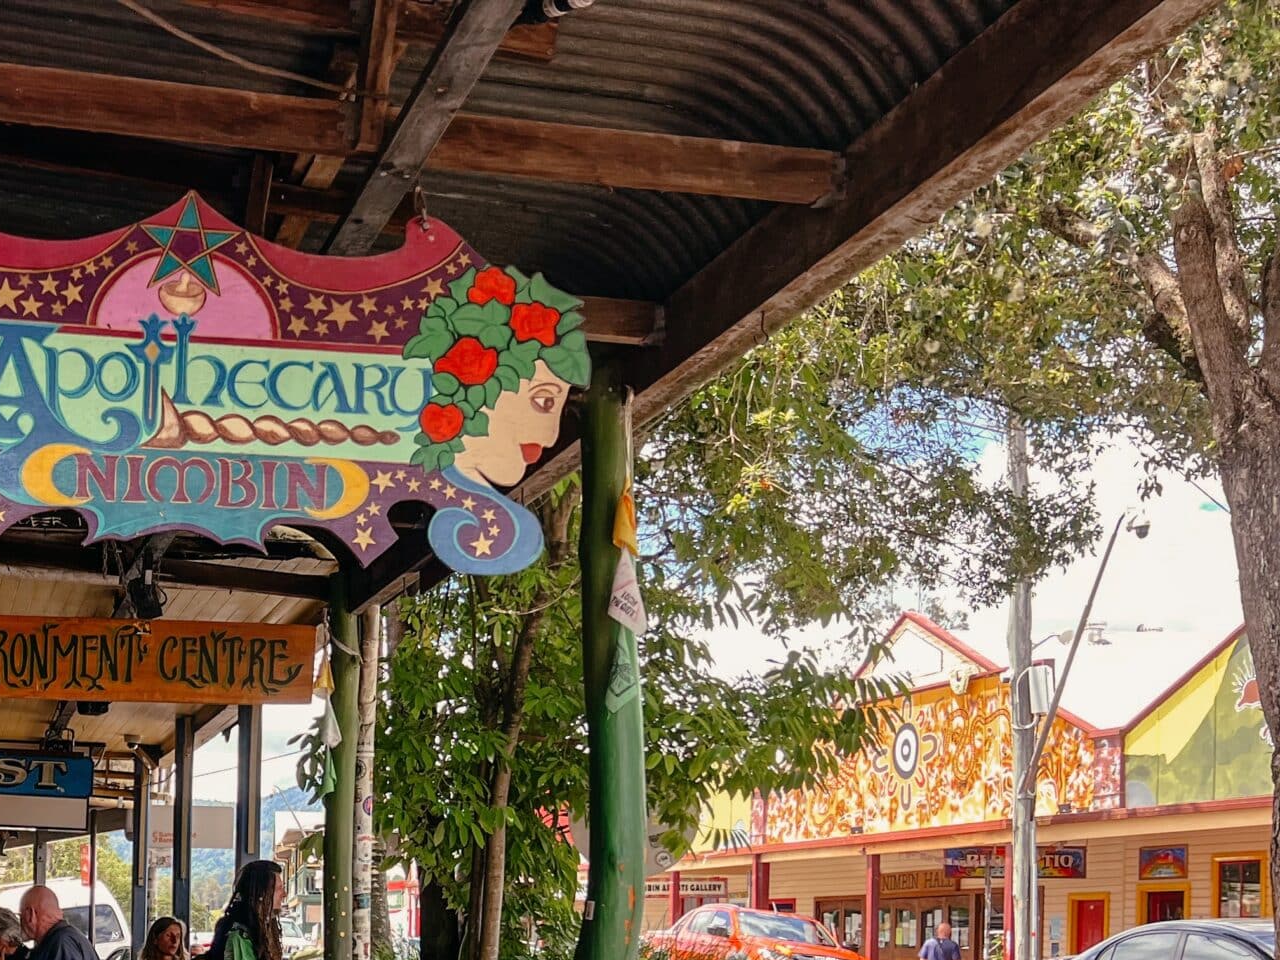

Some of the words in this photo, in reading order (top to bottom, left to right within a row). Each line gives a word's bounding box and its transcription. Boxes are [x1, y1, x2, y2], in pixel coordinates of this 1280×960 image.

[73, 453, 329, 511] NIMBIN
[156, 630, 302, 696] CENTRE
[689, 884, 722, 892] GALLERY
[882, 873, 919, 891] NIMBIN
